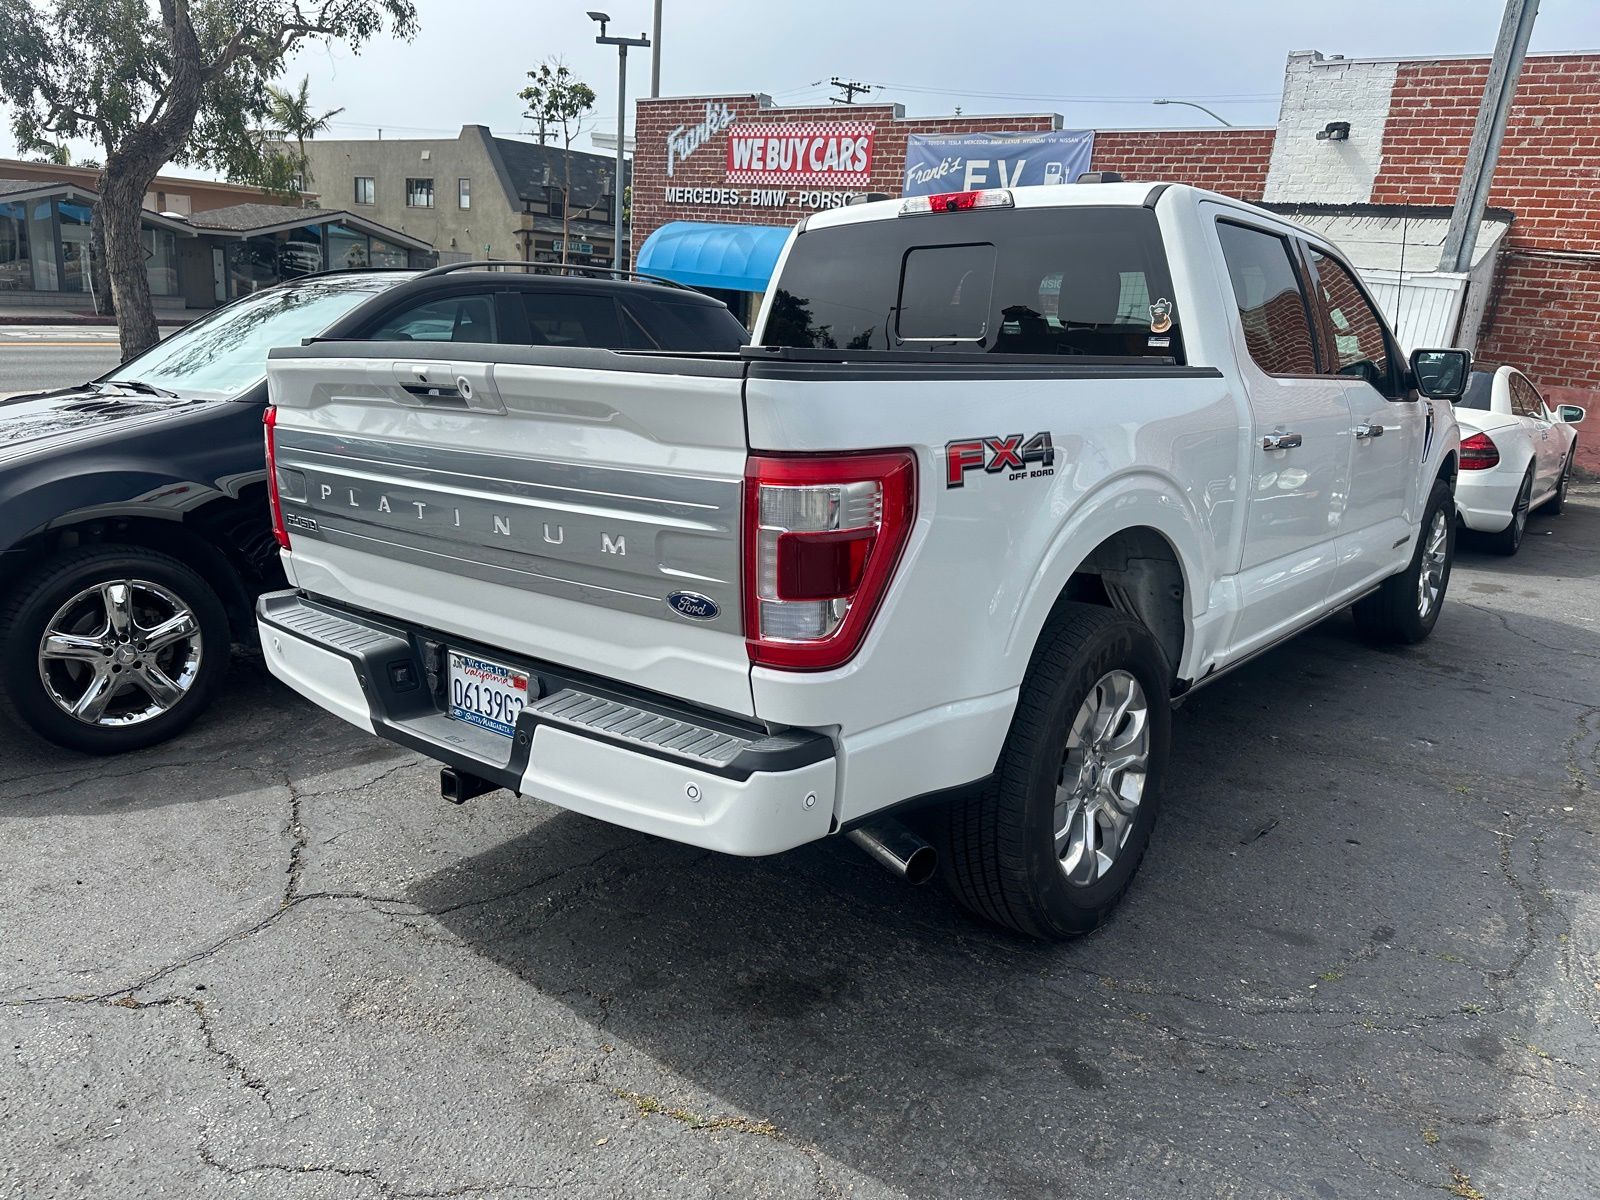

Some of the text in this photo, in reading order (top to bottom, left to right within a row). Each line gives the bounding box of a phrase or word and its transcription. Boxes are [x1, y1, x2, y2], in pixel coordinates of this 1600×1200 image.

[667, 101, 736, 177] Frank's
[732, 136, 869, 173] WE BUY CARS
[906, 157, 963, 192] Frank's
[665, 187, 856, 209] MERCEDES BMW PORSC
[944, 431, 1055, 490] FX4
[1009, 468, 1054, 481] OFF ROAD
[321, 484, 626, 556] PLATINUM
[677, 596, 707, 616] Ford
[467, 658, 479, 669] We
[480, 663, 494, 673] Get
